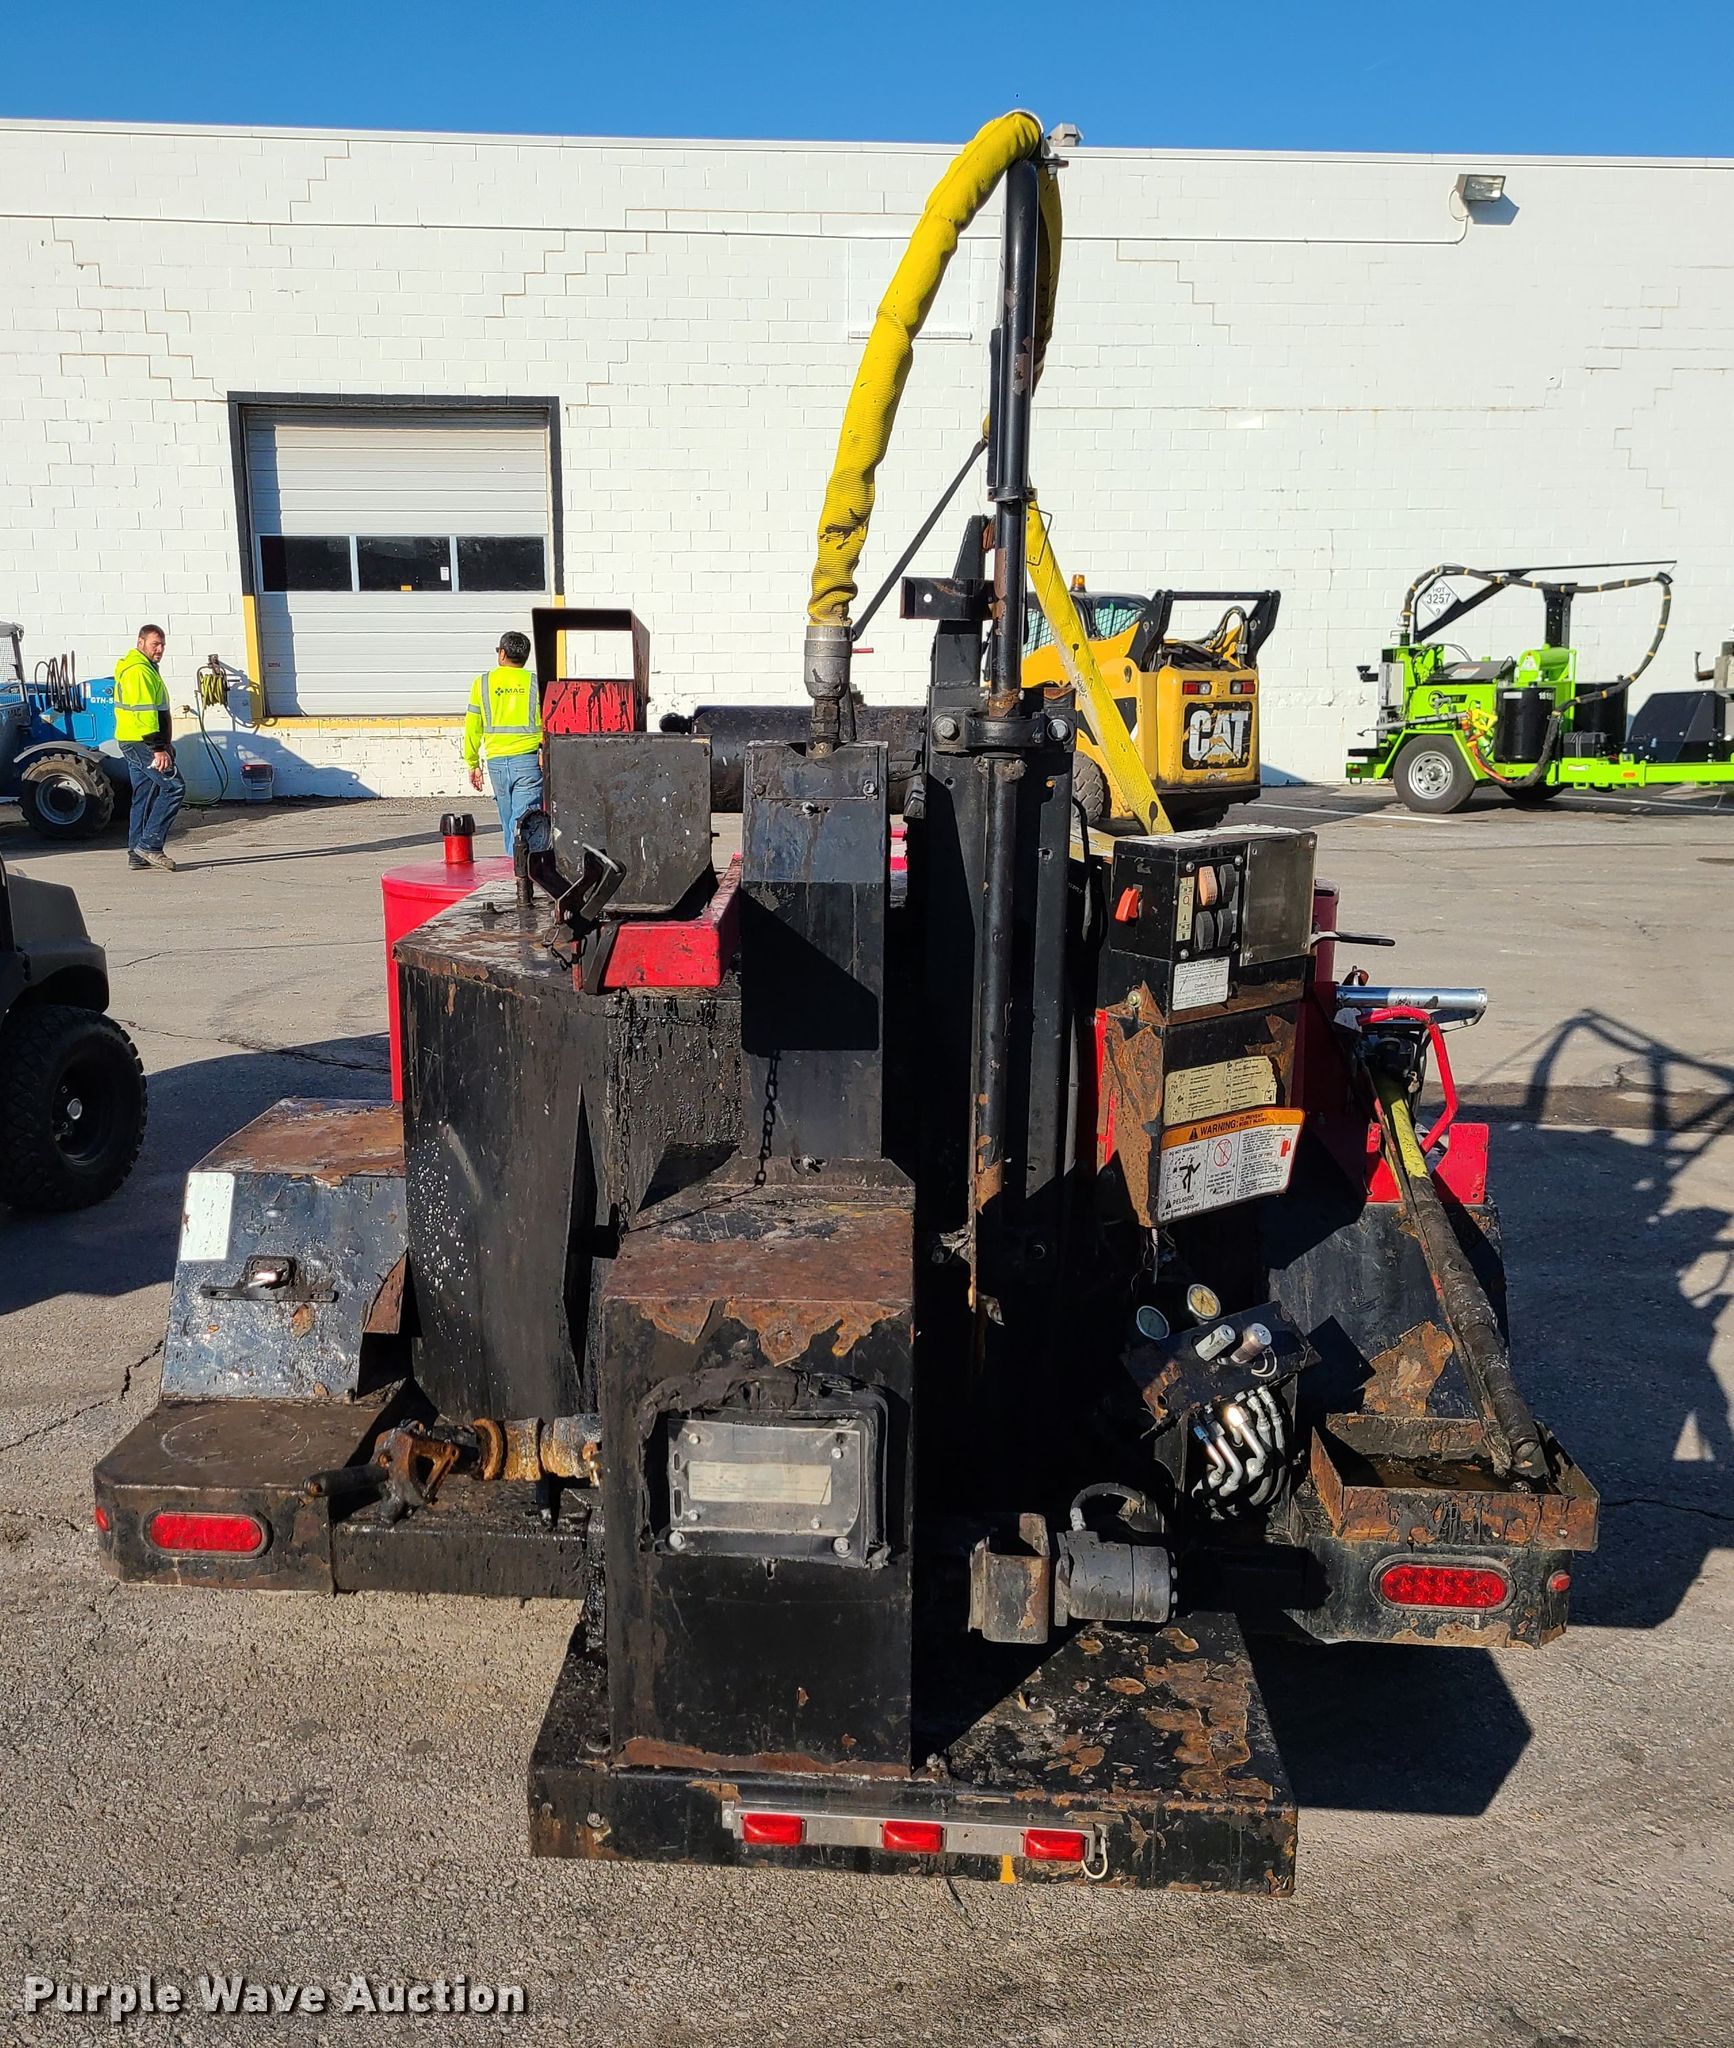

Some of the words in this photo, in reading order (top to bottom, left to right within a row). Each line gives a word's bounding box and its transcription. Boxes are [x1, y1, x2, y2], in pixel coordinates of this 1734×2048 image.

[1426, 593, 1451, 604] 3257
[1188, 709, 1249, 762] CAT
[1172, 1194, 1194, 1205] PELIGRO
